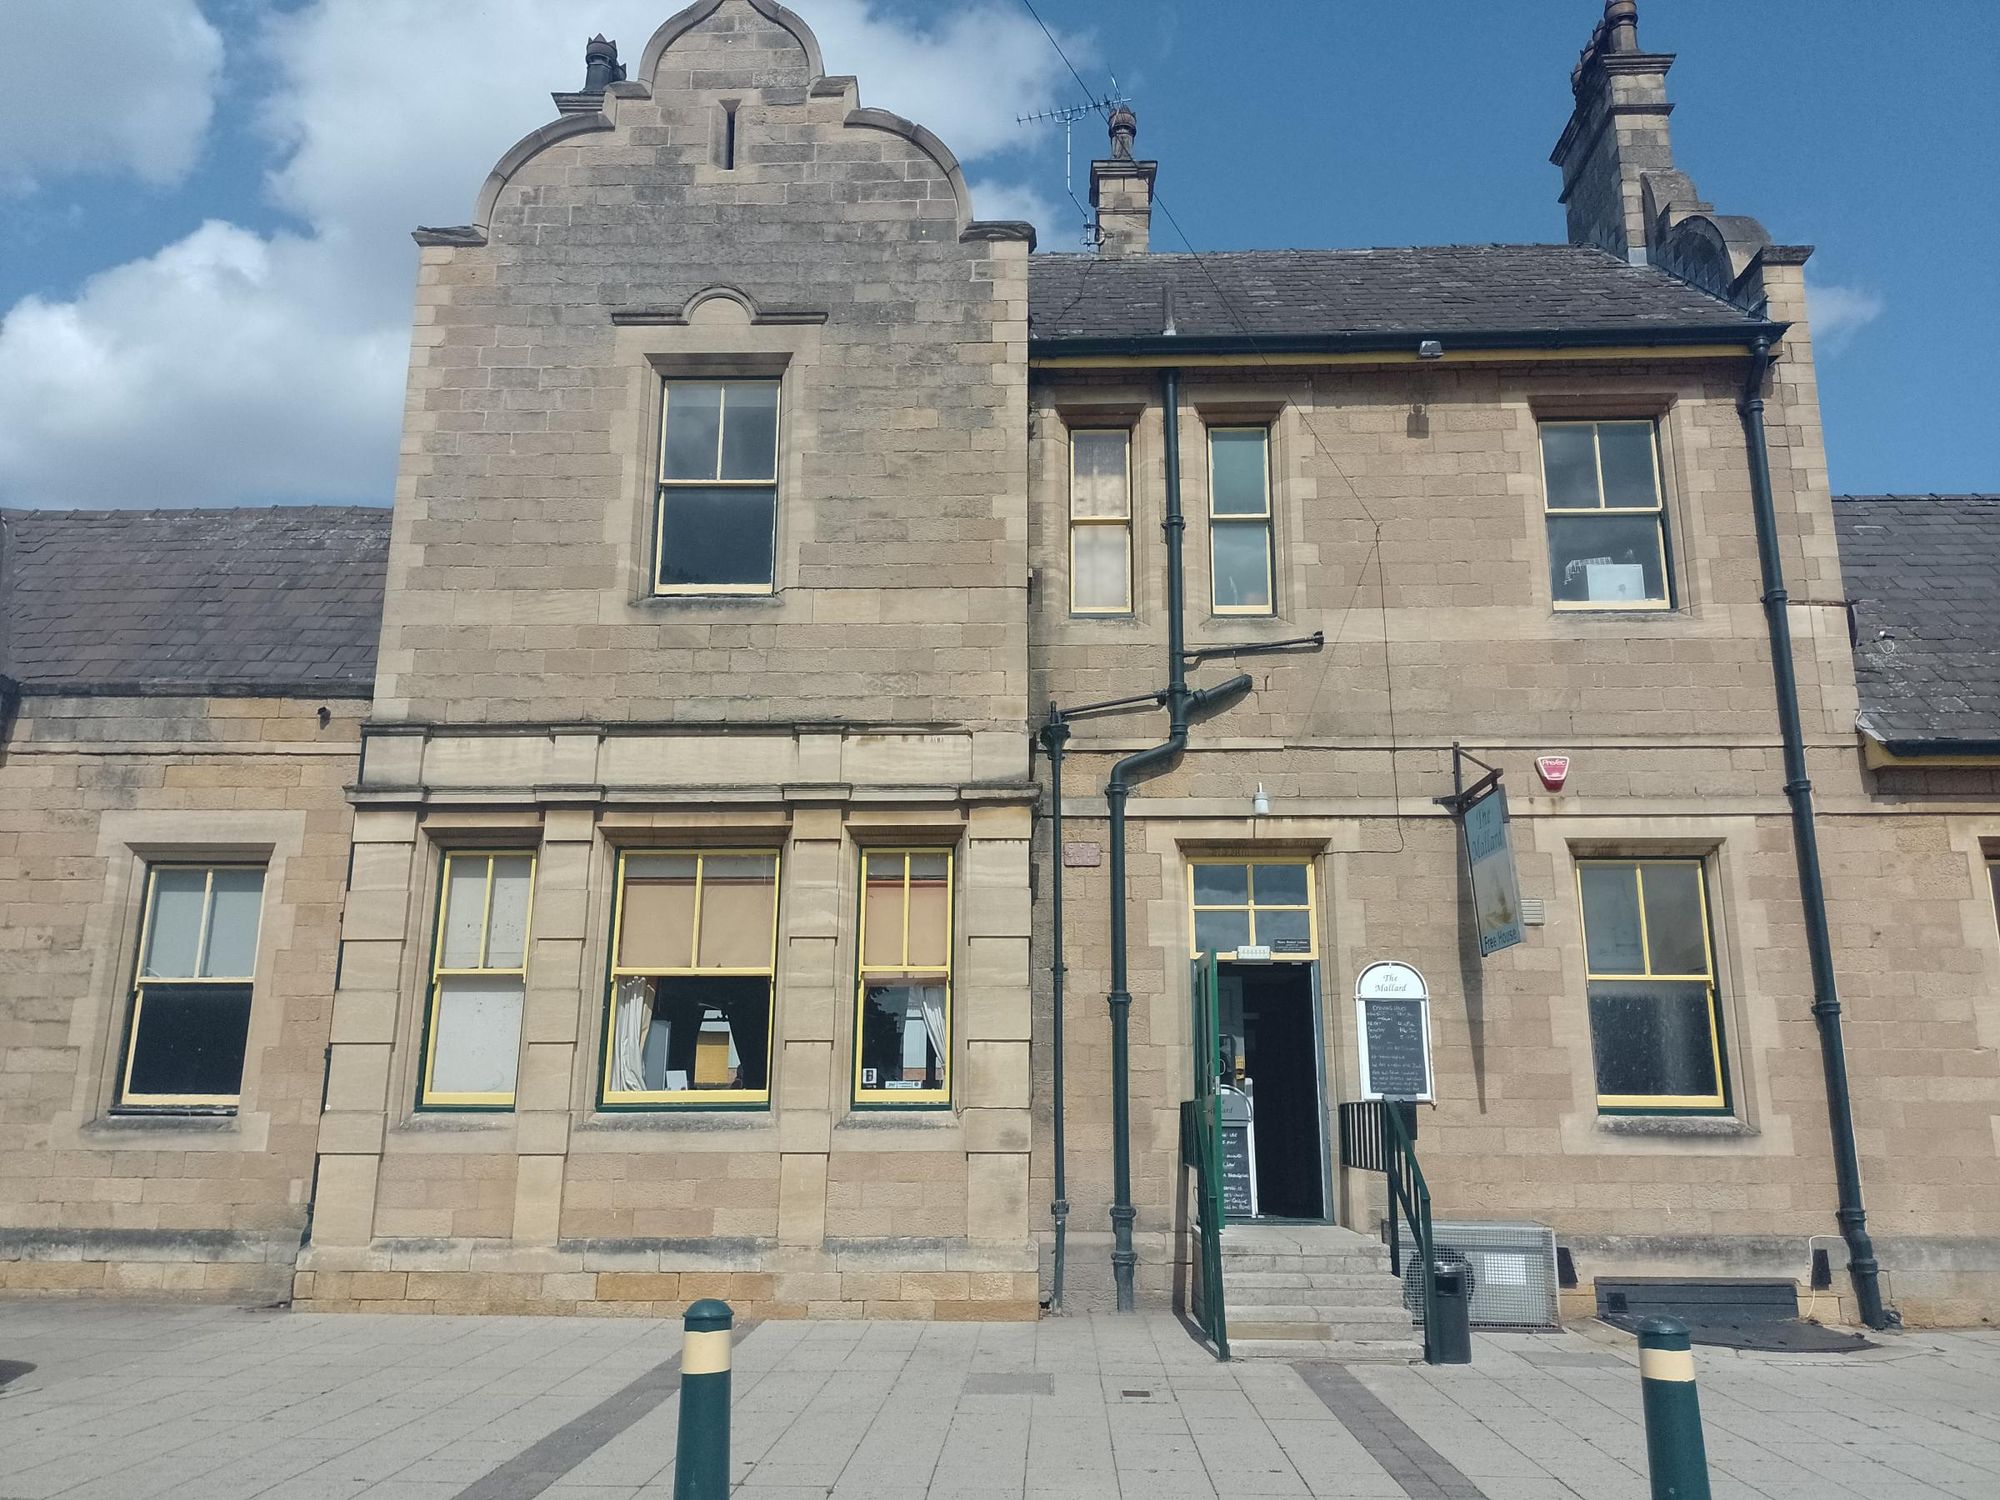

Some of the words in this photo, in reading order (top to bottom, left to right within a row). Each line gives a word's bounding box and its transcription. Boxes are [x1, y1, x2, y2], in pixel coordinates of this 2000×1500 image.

[1476, 809, 1491, 830] The
[1472, 829, 1503, 861] Mallard
[1484, 936, 1497, 951] Free
[1497, 928, 1518, 945] House
[1374, 984, 1407, 992] Mallard
[1383, 974, 1399, 982] The
